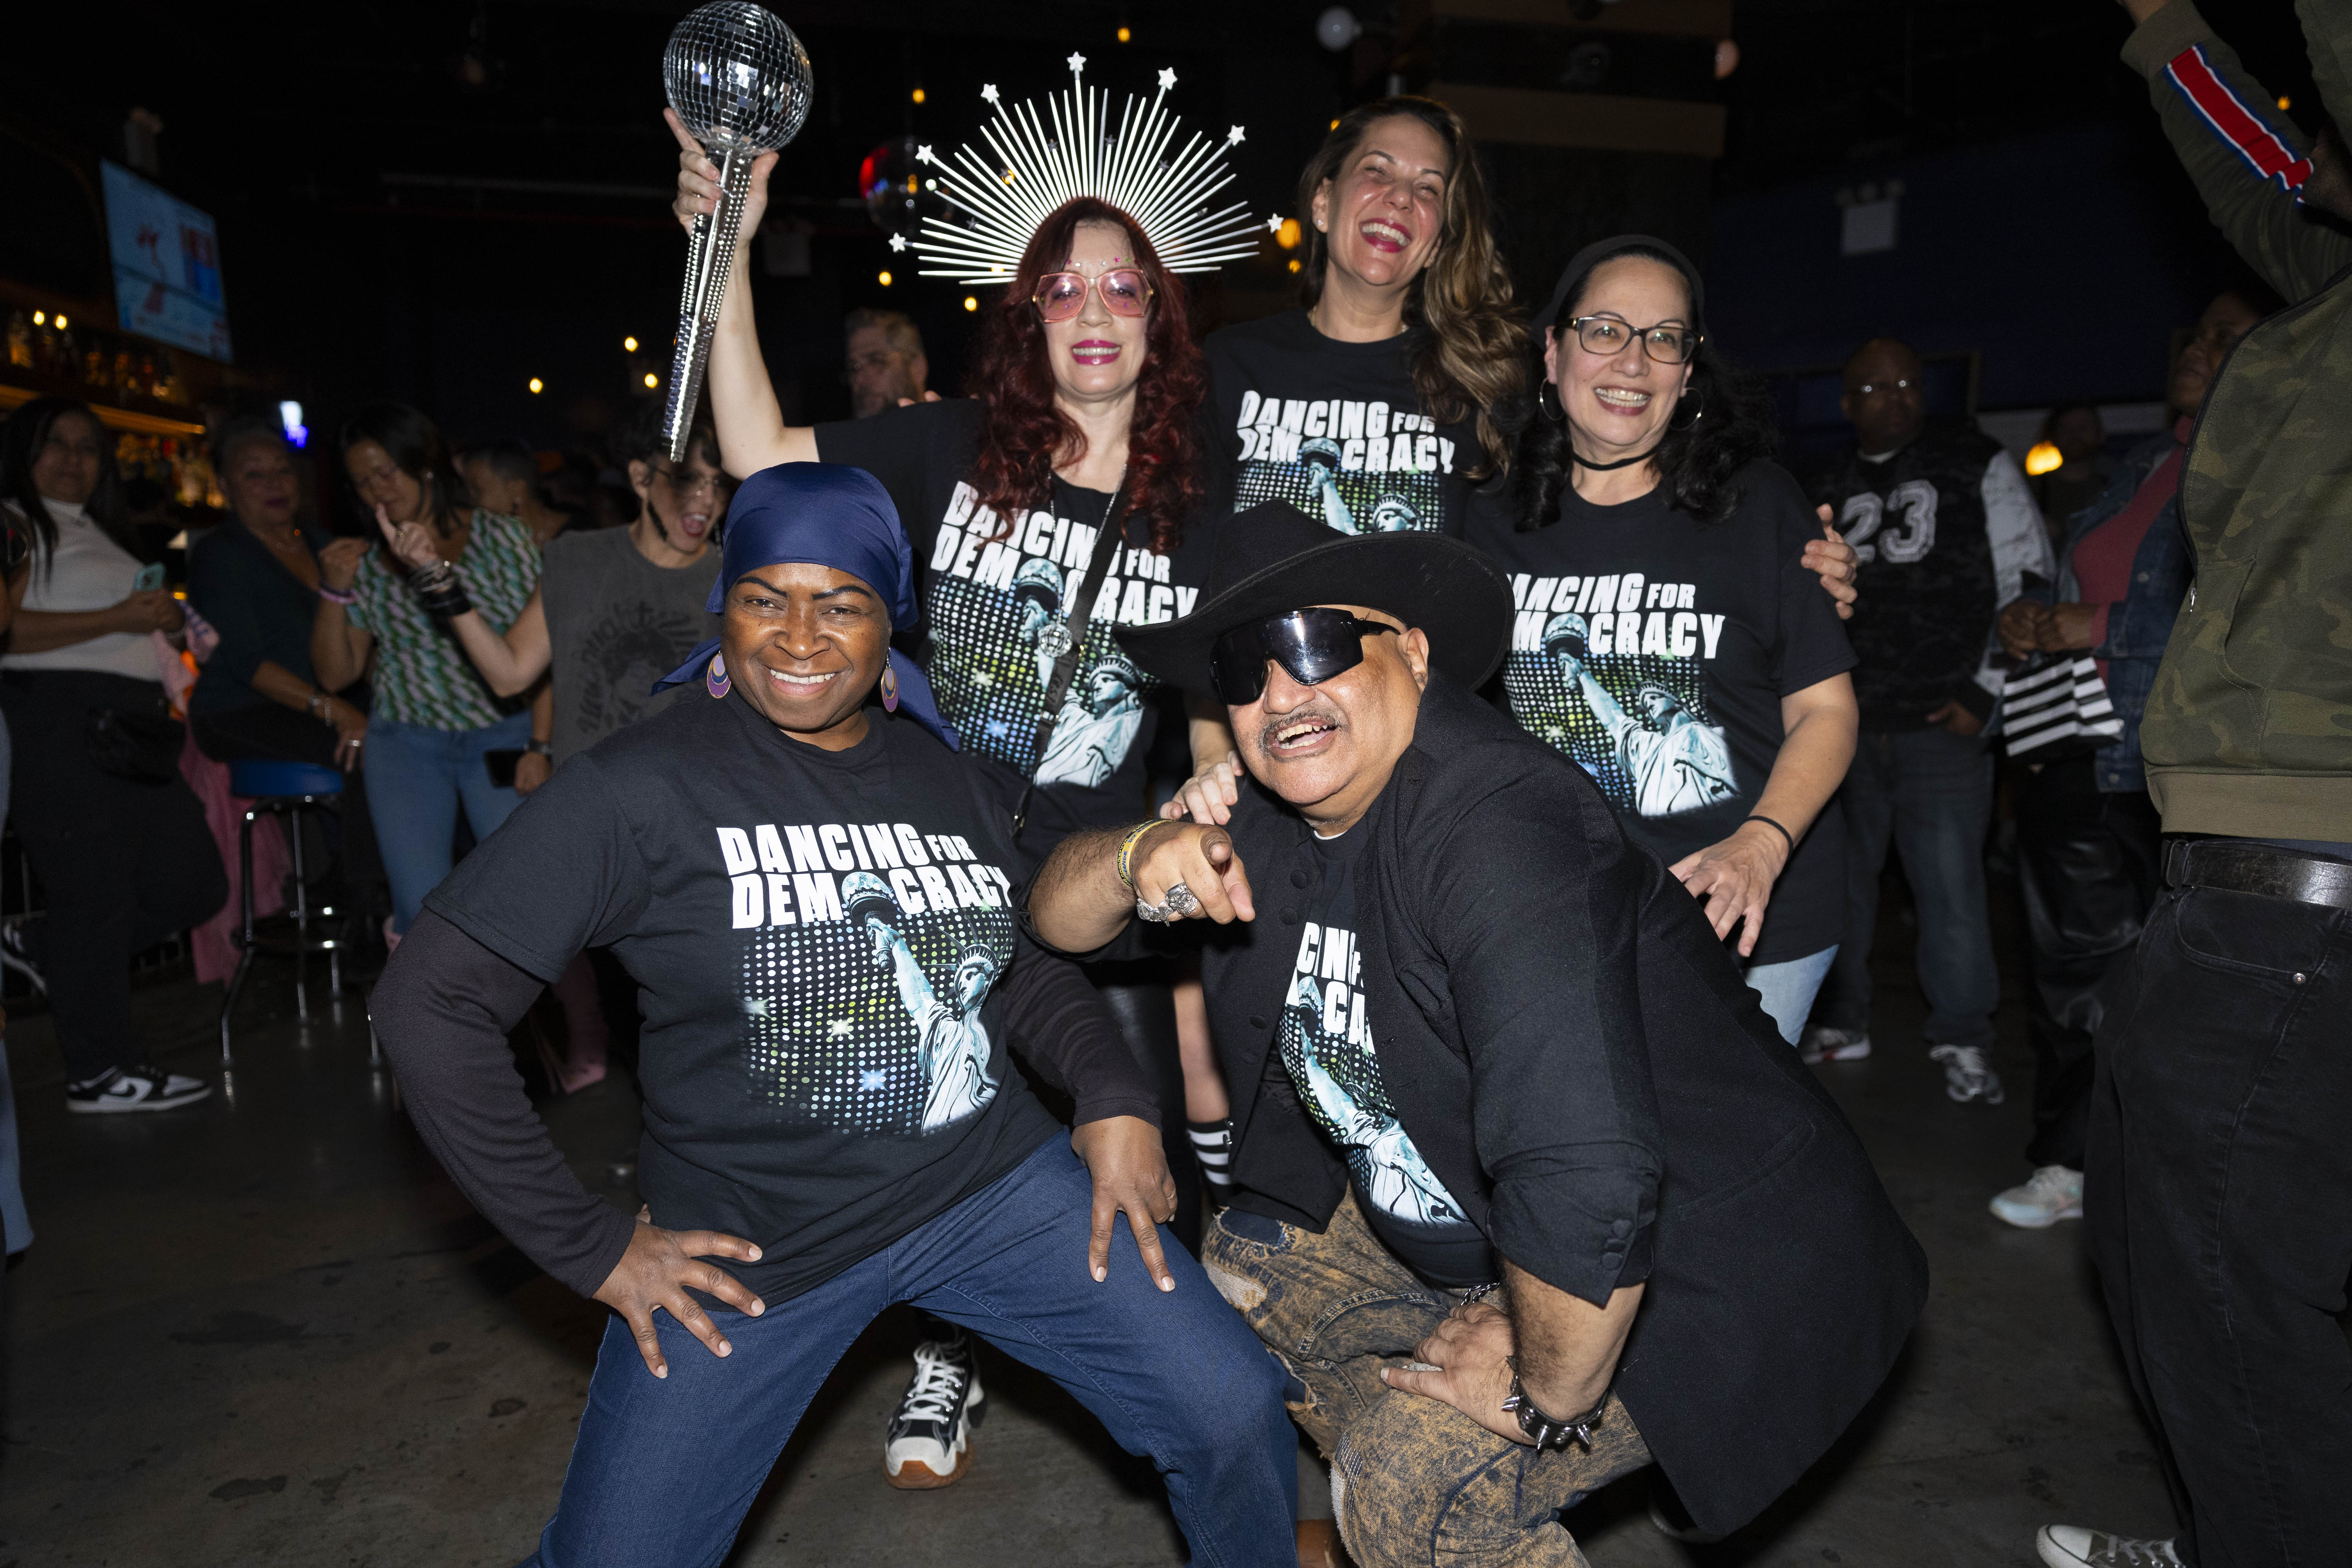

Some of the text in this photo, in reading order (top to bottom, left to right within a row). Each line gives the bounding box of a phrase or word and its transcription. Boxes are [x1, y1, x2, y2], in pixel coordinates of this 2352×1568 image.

[1237, 390, 1436, 439] DANCING FOR
[1842, 479, 1938, 567] 23
[1124, 549, 1171, 584] FOR
[1506, 573, 1696, 613] ANCING FOR
[716, 823, 978, 876] DANCING FOR
